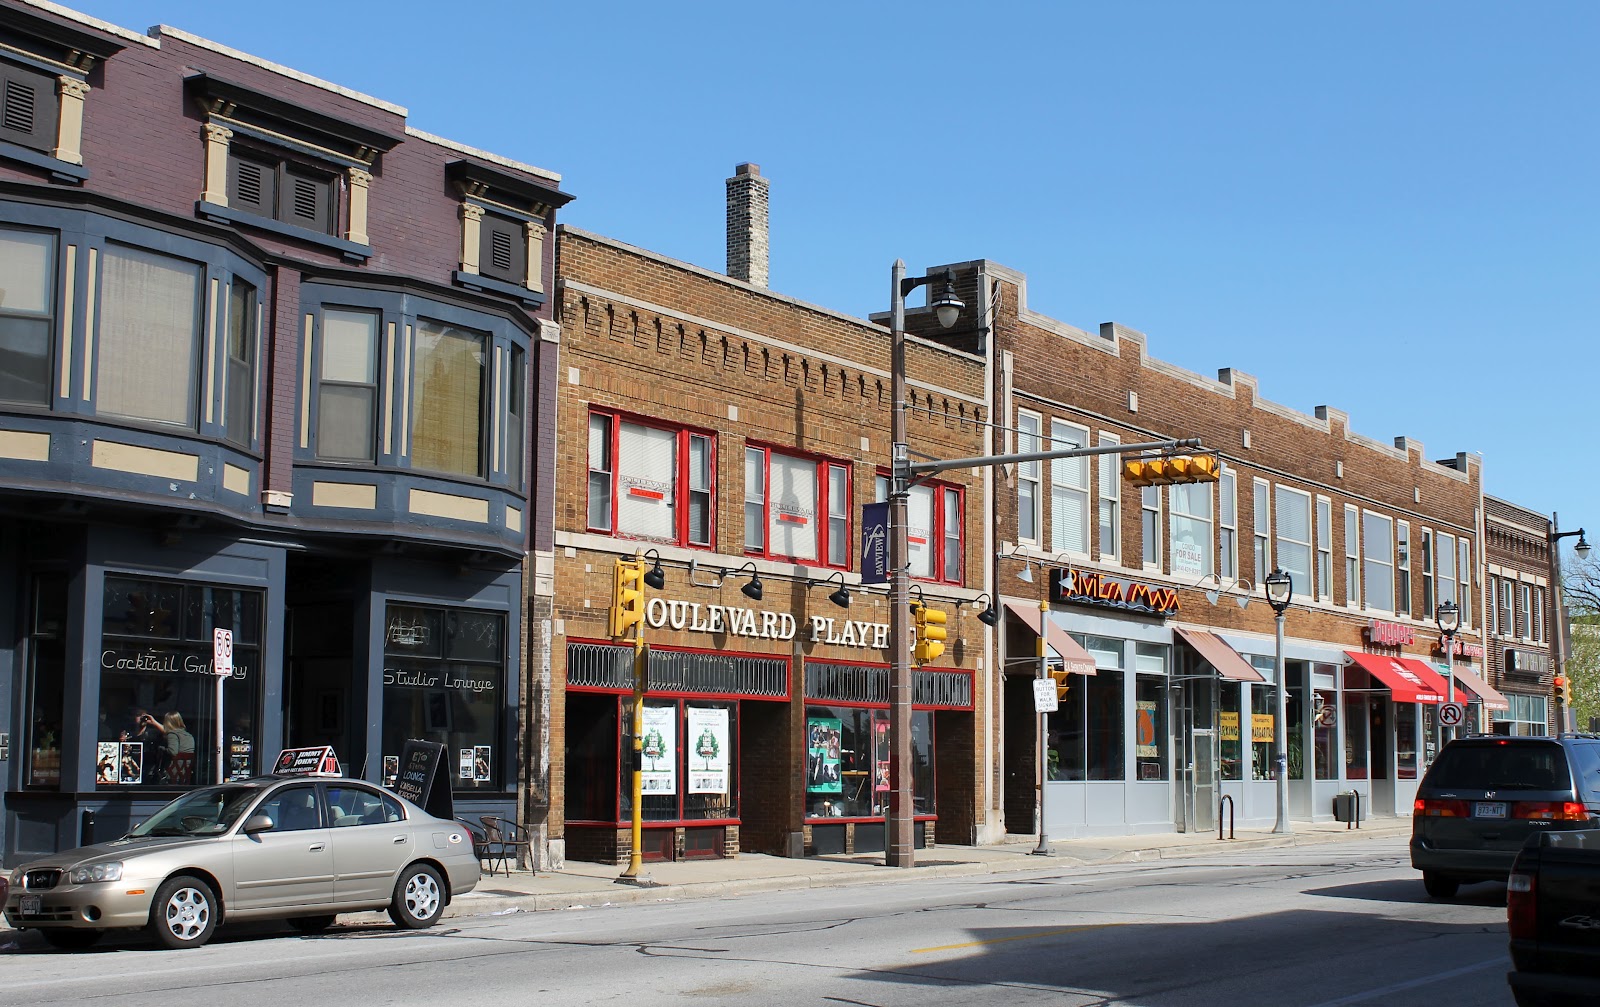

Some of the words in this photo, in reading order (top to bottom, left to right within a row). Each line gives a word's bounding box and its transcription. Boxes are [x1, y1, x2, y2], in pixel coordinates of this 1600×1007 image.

[1187, 551, 1202, 562] SALE
[644, 597, 797, 640] OULEVARD
[810, 615, 917, 652] PLAYH
[101, 650, 179, 672] Cocktail
[184, 655, 248, 680] Galry
[384, 668, 438, 687] Studio
[444, 673, 494, 692] Lounge
[294, 758, 319, 767] JOHN'S
[298, 750, 323, 758] JIMMY
